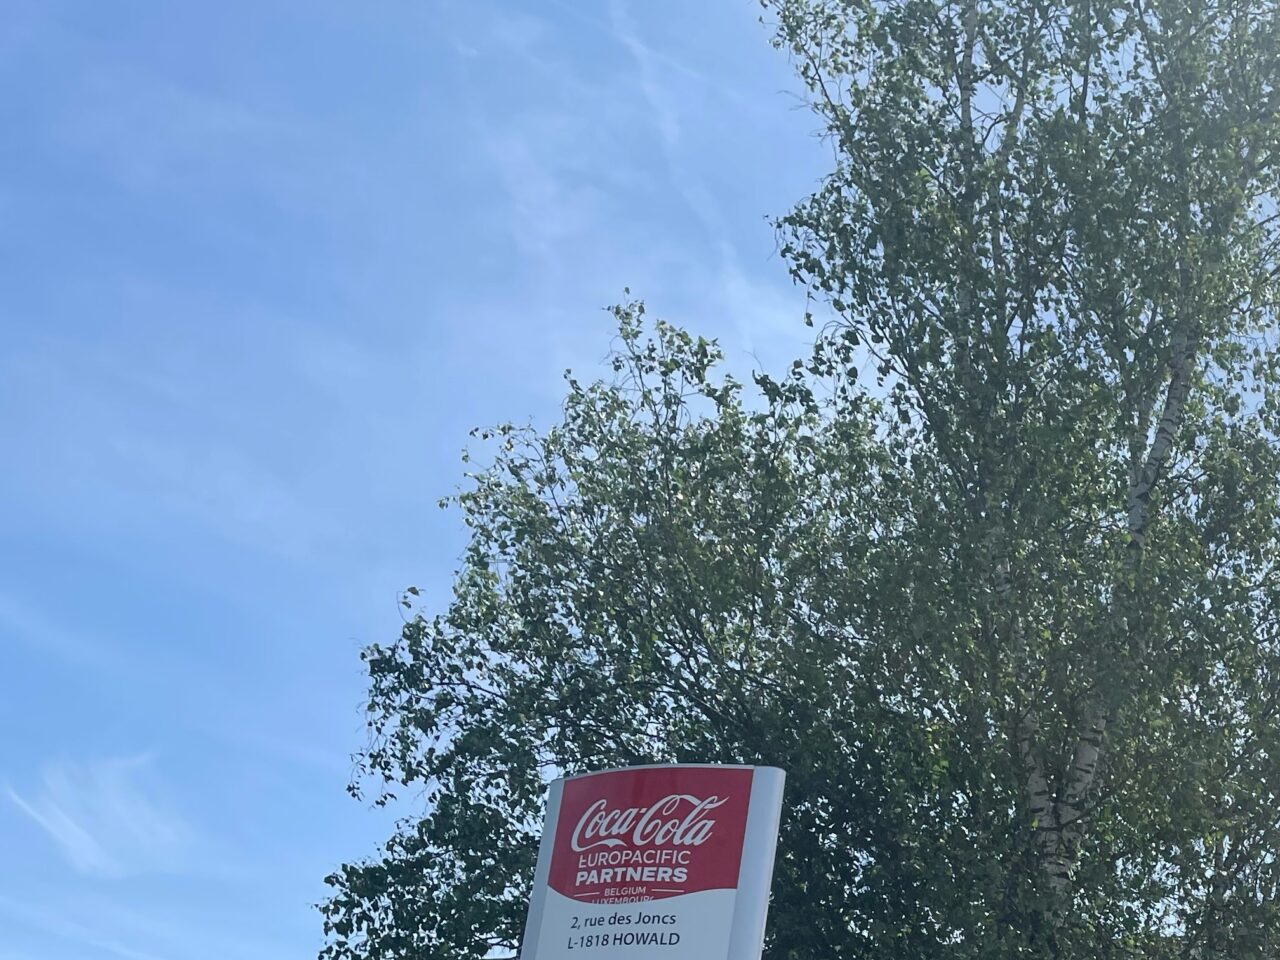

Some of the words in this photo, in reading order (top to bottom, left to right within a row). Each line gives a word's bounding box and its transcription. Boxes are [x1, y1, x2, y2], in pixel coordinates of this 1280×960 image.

[571, 794, 729, 852] Coca-Cola
[578, 850, 691, 868] EUROPACIFIC
[575, 867, 688, 886] PARTNERS
[603, 886, 646, 897] BELGIUM
[570, 916, 581, 930] 2,
[584, 917, 604, 928] rue
[608, 912, 631, 926] des
[635, 912, 676, 926] Joncs
[567, 934, 609, 949] L-1818
[613, 932, 680, 946] HOWALD
